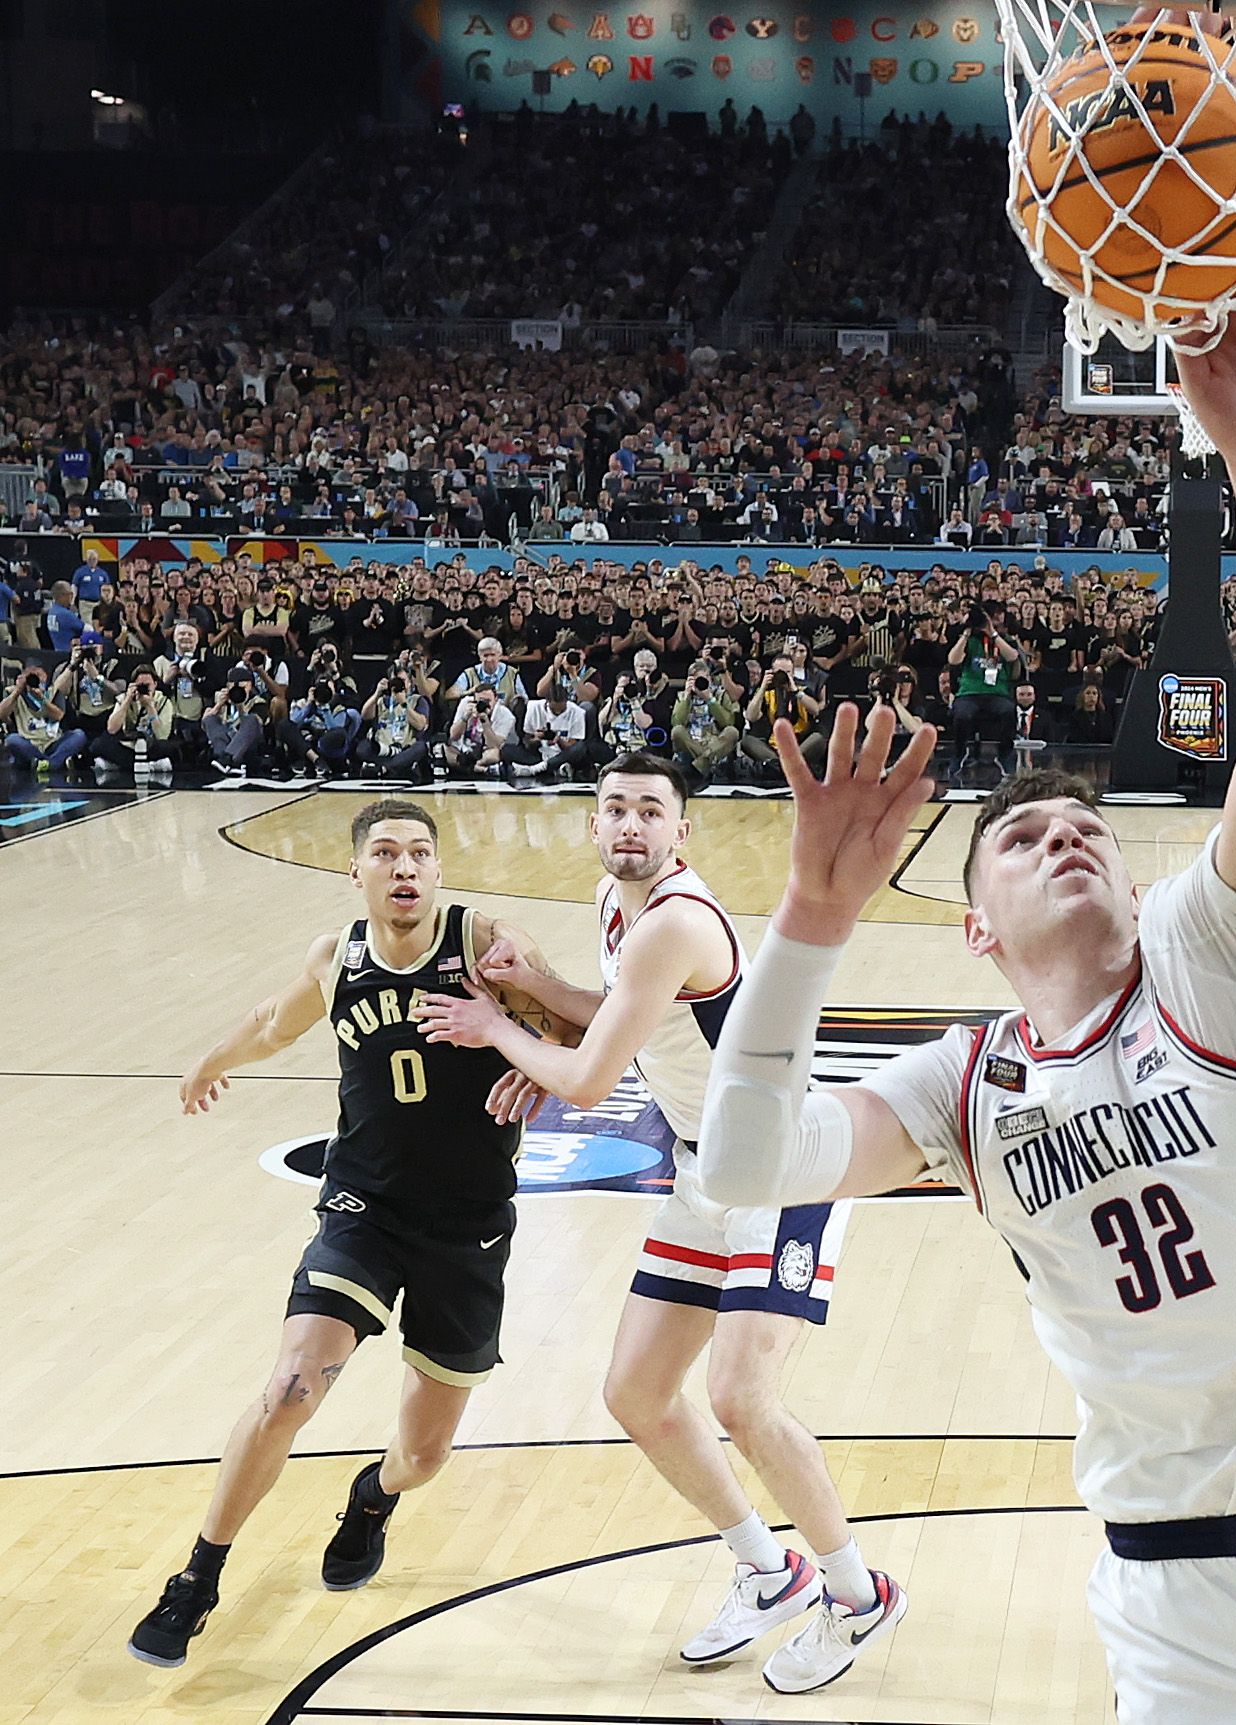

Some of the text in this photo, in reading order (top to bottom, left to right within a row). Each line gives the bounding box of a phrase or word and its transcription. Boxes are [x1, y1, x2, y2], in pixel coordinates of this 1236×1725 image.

[629, 55, 654, 81] N
[1169, 693, 1212, 709] FINAL
[1169, 710, 1211, 726] FOUR
[336, 988, 428, 1051] PURD
[1136, 1051, 1167, 1079] EAST
[1137, 1047, 1158, 1069] BIG
[390, 1049, 427, 1103] 0
[1002, 1085, 1217, 1217] CONNECTICUT
[1090, 1183, 1217, 1313] 32
